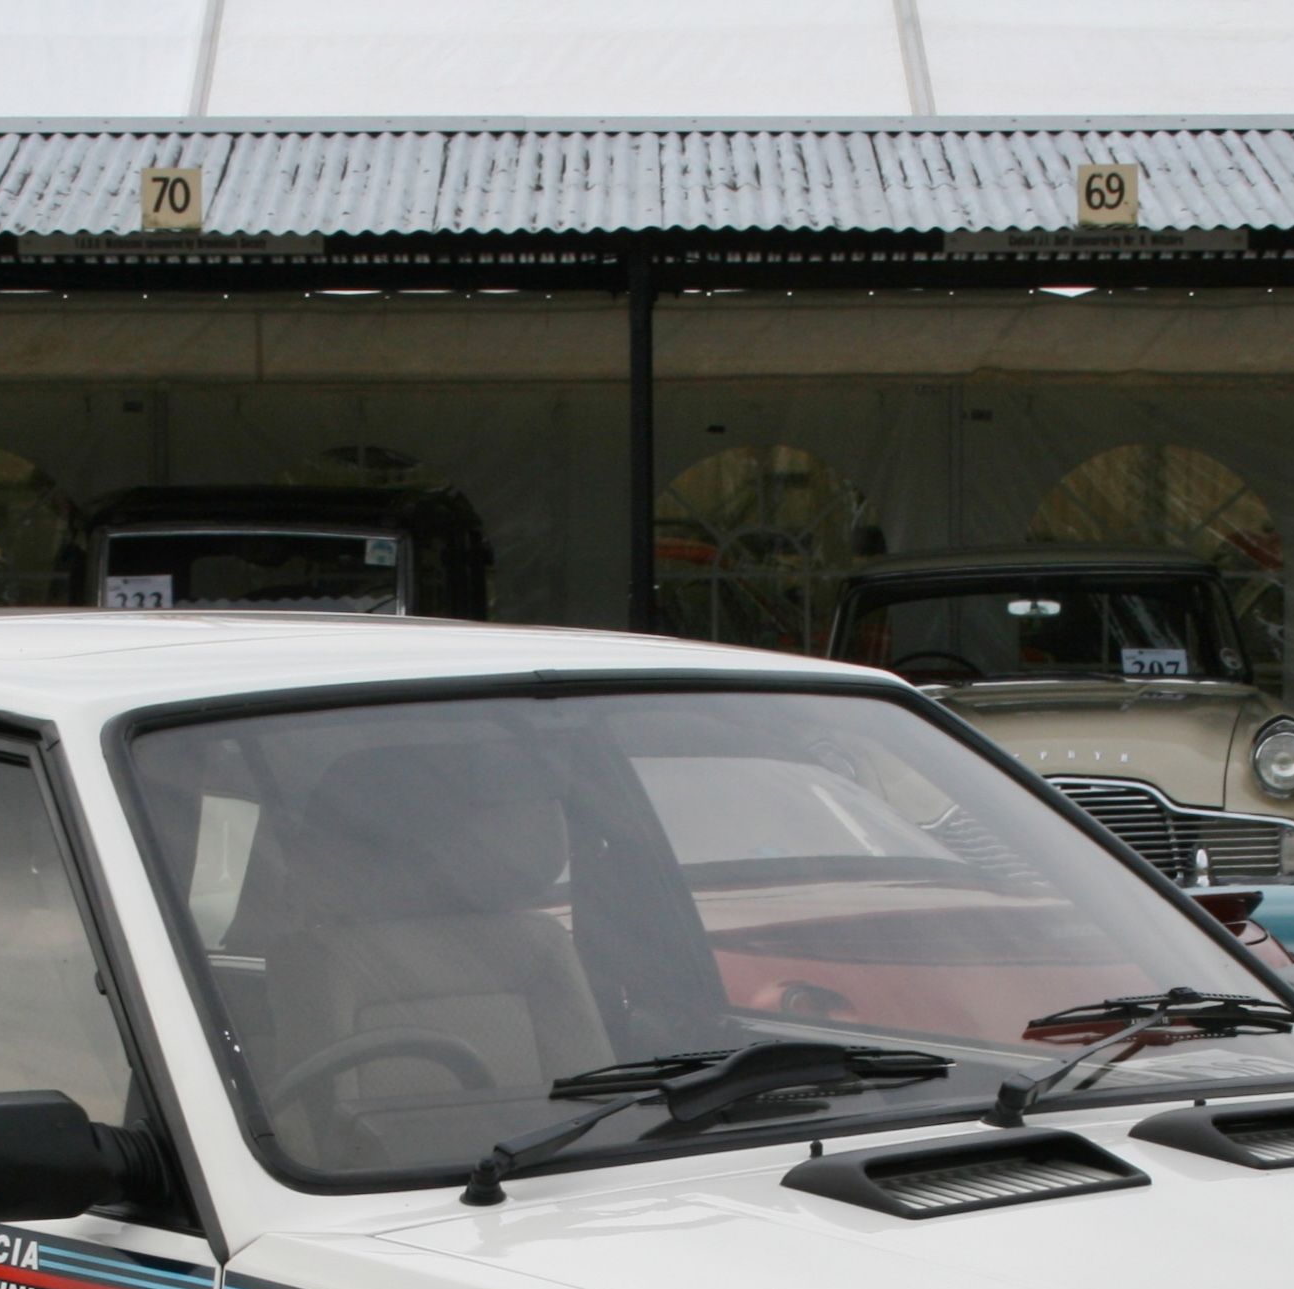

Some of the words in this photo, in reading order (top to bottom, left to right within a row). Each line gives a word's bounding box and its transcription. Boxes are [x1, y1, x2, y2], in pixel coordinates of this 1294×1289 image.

[151, 176, 191, 214] 70
[1085, 172, 1125, 210] 69
[1131, 660, 1180, 674] 207
